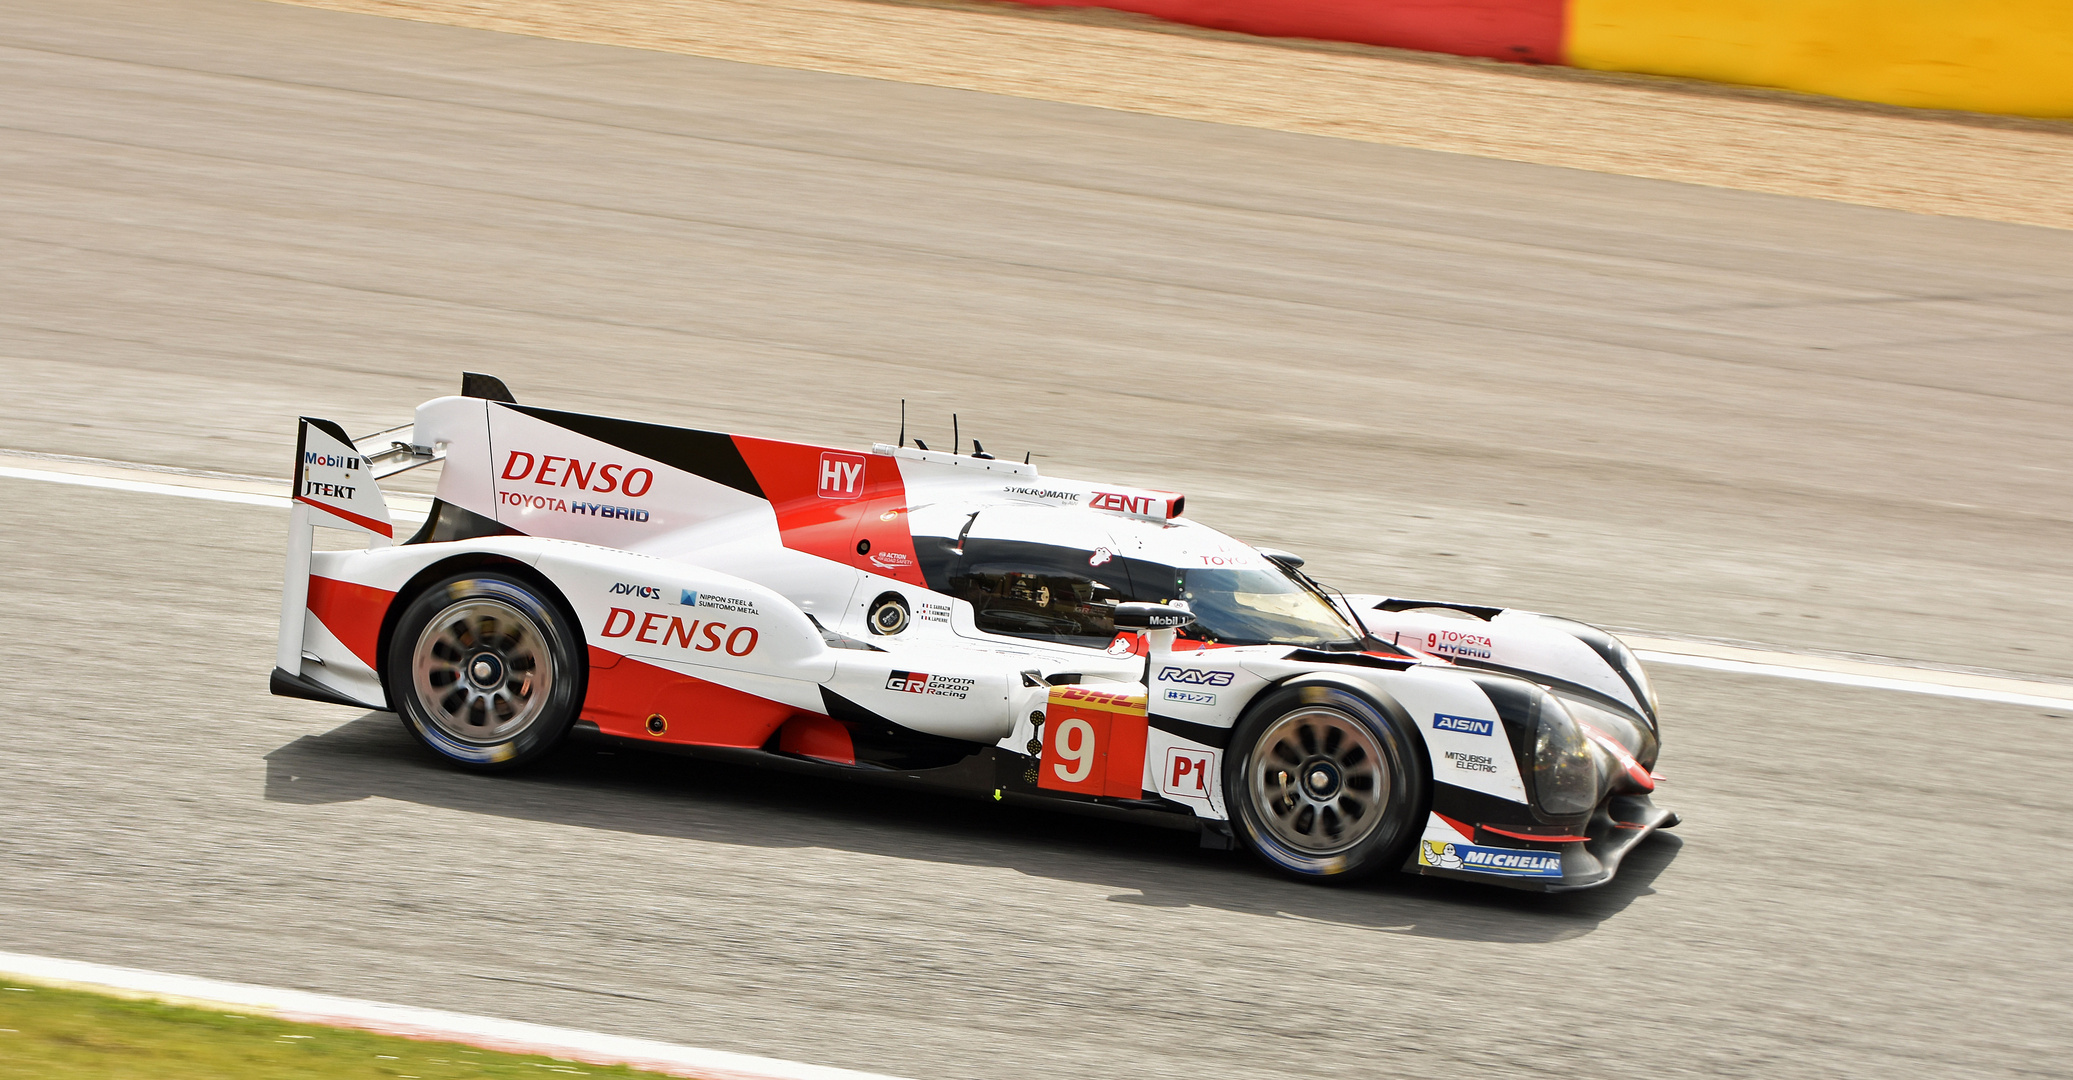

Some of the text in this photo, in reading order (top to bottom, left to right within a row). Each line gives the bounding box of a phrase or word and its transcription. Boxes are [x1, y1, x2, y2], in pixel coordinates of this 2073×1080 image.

[305, 451, 360, 471] Mobil 1
[501, 450, 654, 497] DENSO
[821, 459, 862, 493] HY
[304, 481, 356, 500] JTEKT
[499, 491, 650, 523] TOYOTA HYBRID
[1089, 491, 1156, 515] ZENT
[886, 552, 907, 560] ACTION
[1200, 555, 1259, 566] TOYO
[698, 600, 760, 616] SUMITOMO METAL
[699, 593, 727, 603] NIPPON
[727, 597, 747, 606] STEEL
[1149, 616, 1179, 626] Mobil
[601, 607, 759, 657] DENSO
[1427, 633, 1437, 648] 9
[1441, 630, 1492, 648] TOYOTA
[1438, 643, 1491, 660] HYBRID
[932, 674, 975, 685] TOYOTA
[1158, 667, 1235, 686] RAYS
[887, 678, 925, 693] GR
[926, 688, 967, 700] Racing
[928, 682, 969, 692] GAZOO
[1061, 686, 1133, 708] DHL
[1437, 716, 1490, 733] AISIN
[1053, 718, 1096, 783] 9
[1444, 751, 1492, 764] MITSUBISHI
[1172, 756, 1206, 790] P1
[1456, 760, 1498, 773] ELECTRIC
[1464, 851, 1560, 870] MICHELIN
